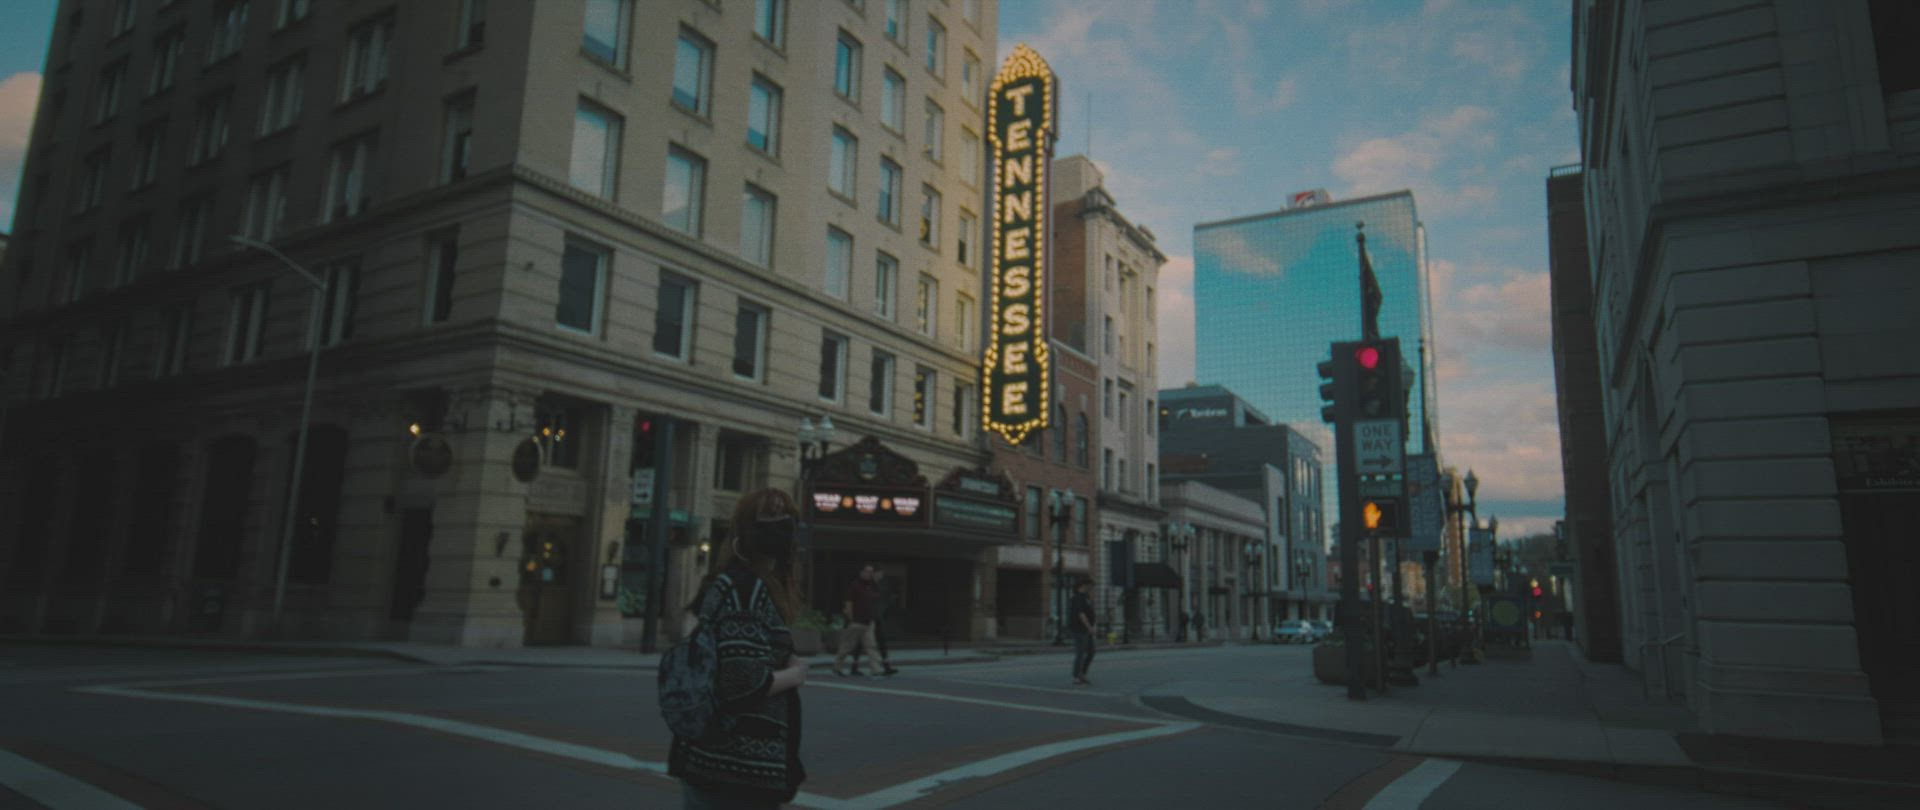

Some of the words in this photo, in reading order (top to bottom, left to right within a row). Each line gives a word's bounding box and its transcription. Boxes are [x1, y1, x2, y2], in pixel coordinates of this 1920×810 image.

[1002, 83, 1034, 416] TENNESSEE
[1362, 424, 1392, 437] ONE
[1361, 439, 1392, 451] WAY
